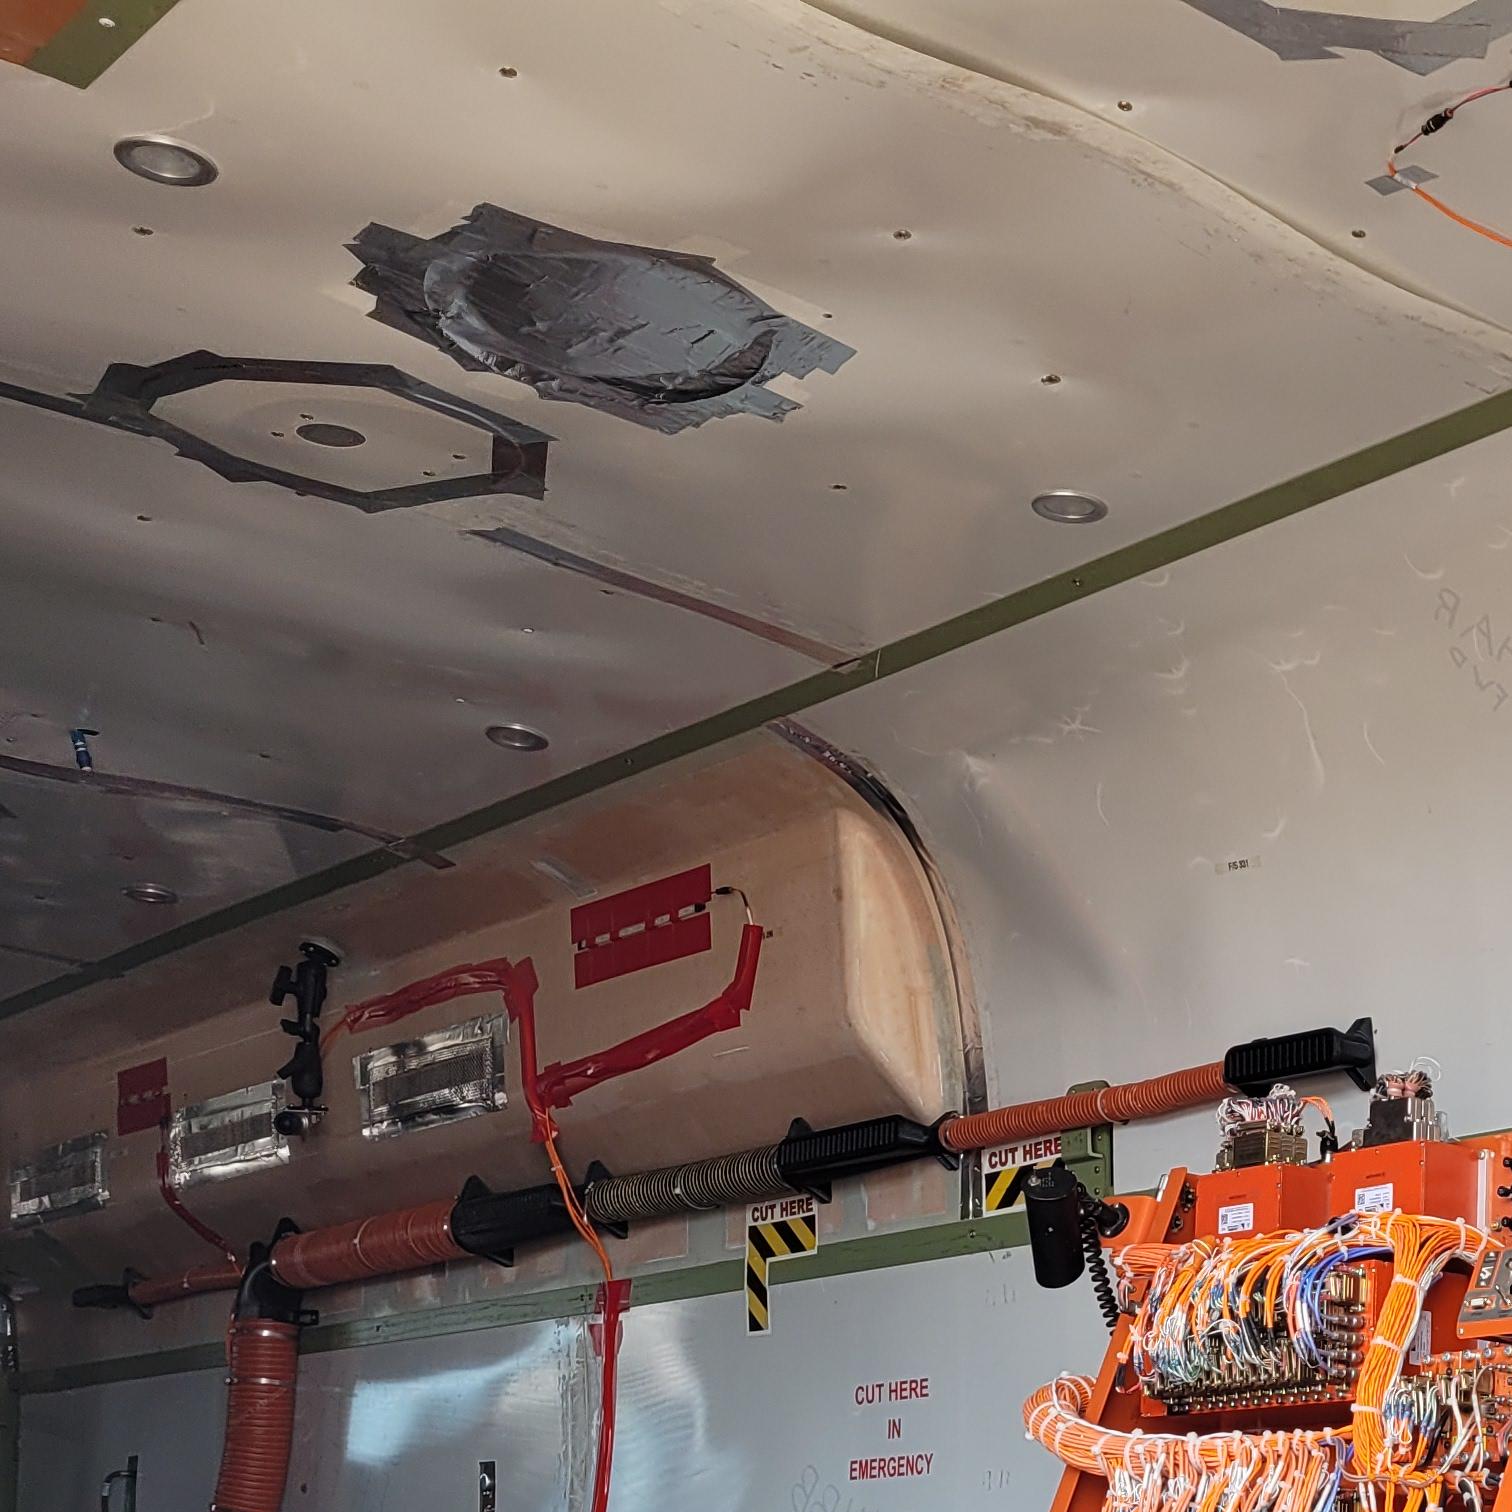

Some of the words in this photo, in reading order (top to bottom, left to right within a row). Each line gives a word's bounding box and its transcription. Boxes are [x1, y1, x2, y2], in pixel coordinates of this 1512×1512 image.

[987, 1145, 1018, 1170] CUT
[1021, 1136, 1062, 1164] HERE
[750, 1203, 778, 1223] CUT
[779, 1196, 814, 1219] HERE
[854, 1382, 885, 1406] CUT
[888, 1378, 930, 1402] HERE
[887, 1418, 902, 1440] IN
[849, 1453, 934, 1481] EMERGENCY
